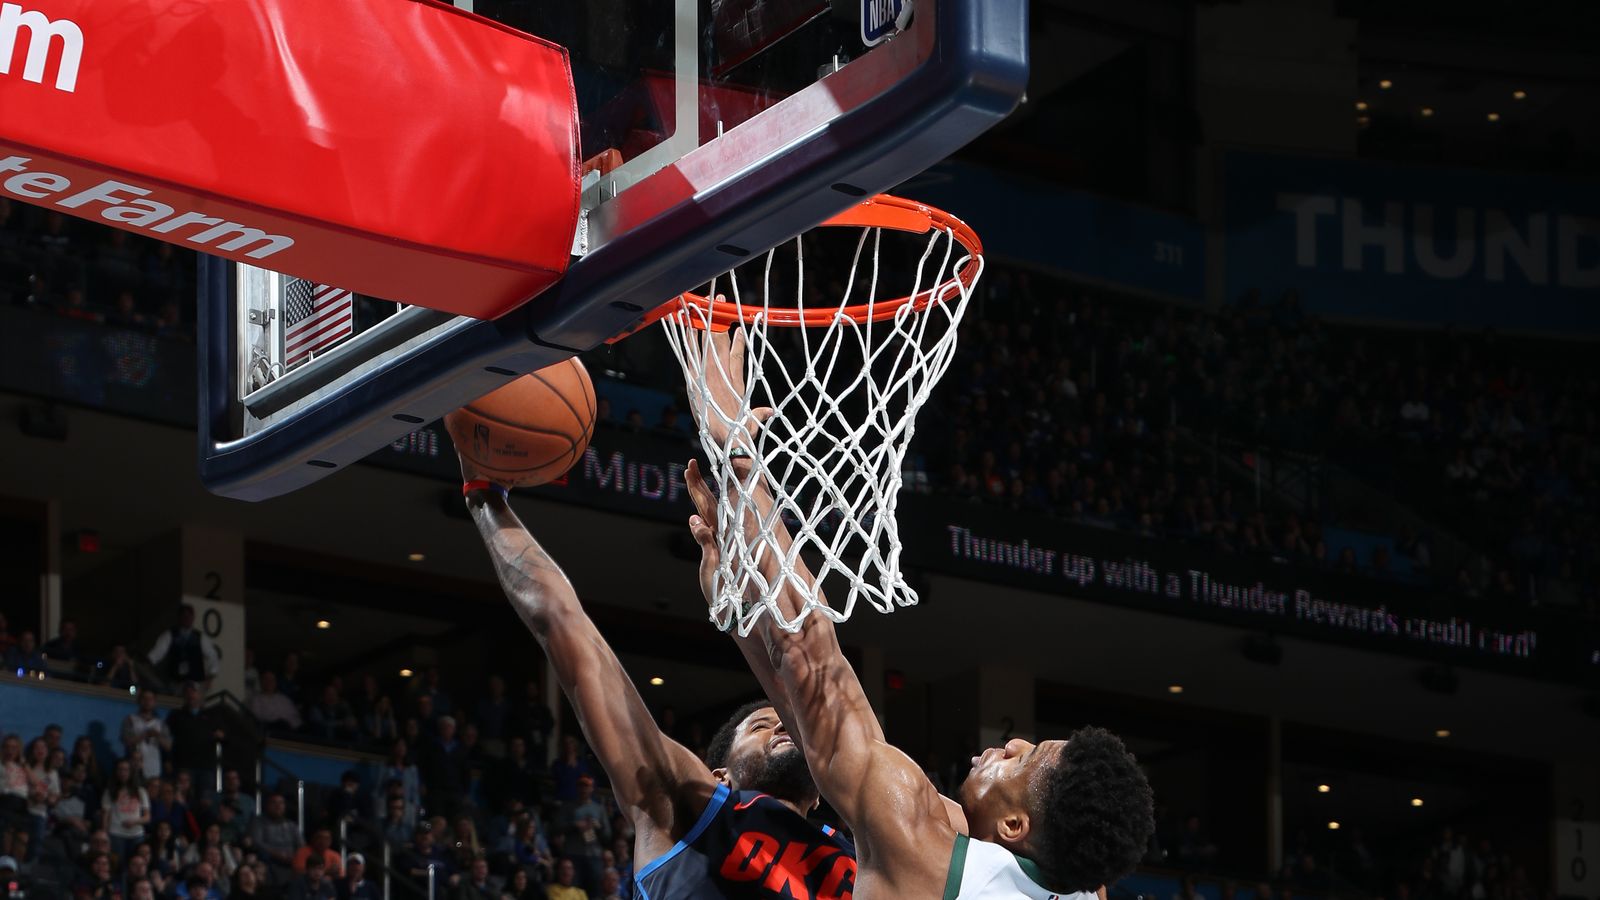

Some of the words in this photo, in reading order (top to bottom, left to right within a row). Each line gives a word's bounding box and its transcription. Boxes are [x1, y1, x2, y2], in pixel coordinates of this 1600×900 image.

[869, 0, 896, 32] NBA
[1274, 191, 1600, 289] THUND
[947, 523, 1057, 576] Thunder
[1062, 551, 1096, 587] up
[1102, 557, 1159, 595] with
[1165, 572, 1182, 599] a
[1186, 568, 1288, 616] Thunder
[1295, 588, 1399, 636] Rewards
